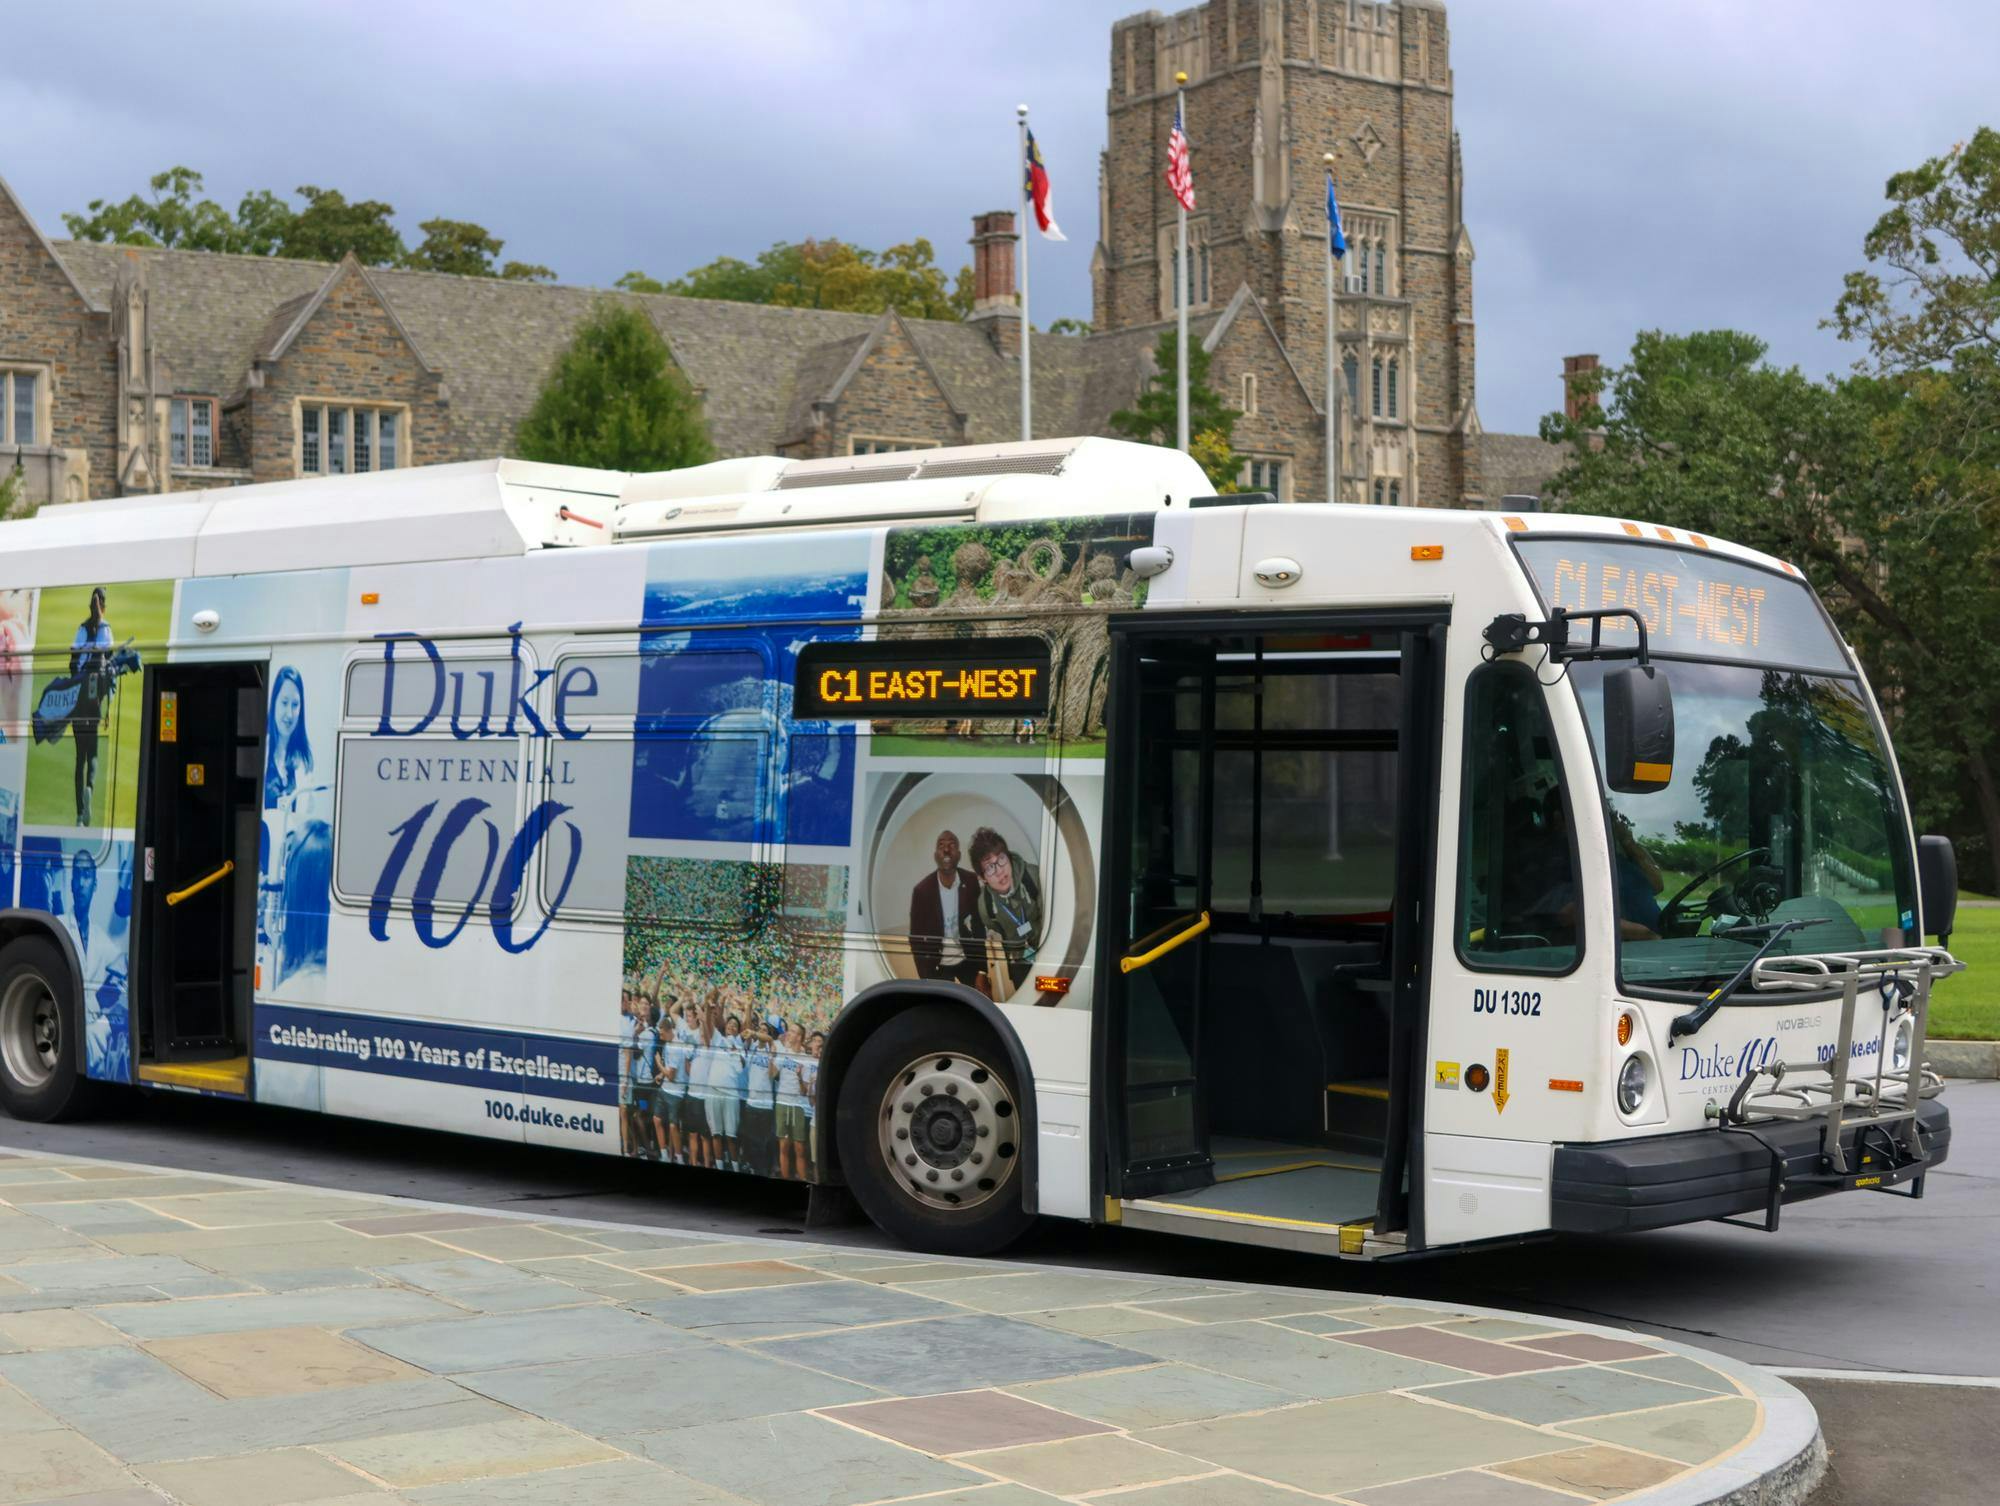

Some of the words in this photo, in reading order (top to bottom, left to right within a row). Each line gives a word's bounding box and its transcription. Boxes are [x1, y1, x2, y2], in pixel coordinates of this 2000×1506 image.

[1601, 563, 1765, 647] EAST-WEST
[370, 621, 599, 740] Duke
[820, 670, 862, 701] C1
[869, 669, 1037, 699] EAST-WEST
[377, 757, 576, 784] CENTENNIAL
[369, 797, 582, 953] 100
[1474, 989, 1497, 1014] DU
[1501, 990, 1541, 1016] 1302
[270, 1024, 370, 1060] Celebrating
[374, 1036, 405, 1060] 100
[409, 1042, 460, 1067] Years
[465, 1049, 484, 1070] of
[490, 1051, 605, 1086] Excellence.
[1680, 1043, 1734, 1080] Duke
[1736, 1037, 1777, 1078] 100
[485, 1100, 604, 1134] 100.duke.edu
